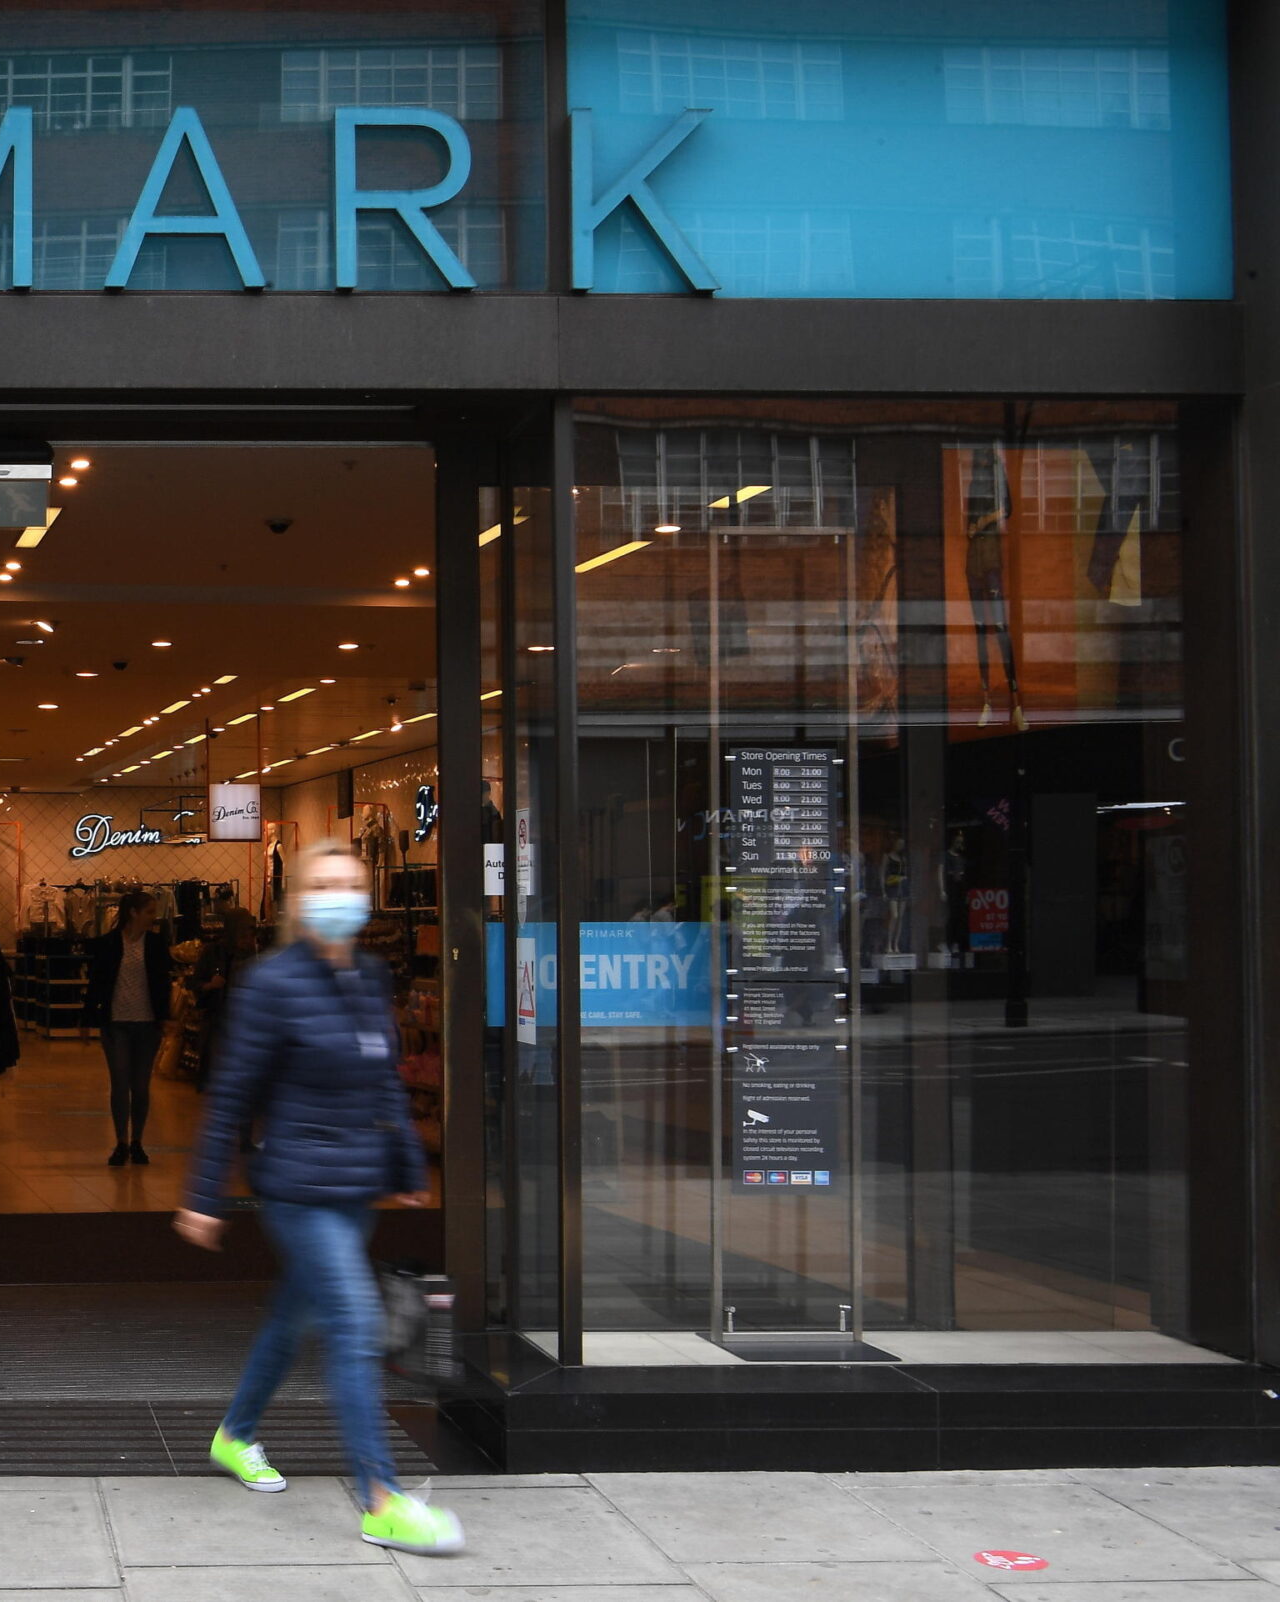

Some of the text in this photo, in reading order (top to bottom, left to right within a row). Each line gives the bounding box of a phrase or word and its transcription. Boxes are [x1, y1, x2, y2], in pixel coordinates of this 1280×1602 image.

[741, 752, 827, 762] Store Opening Times
[801, 768, 822, 776] 21.00
[742, 781, 762, 790] Tues
[801, 781, 821, 789] 21.00
[742, 795, 762, 804] Wed
[801, 796, 822, 804] 21.00
[212, 806, 244, 822] Denim
[801, 823, 822, 831] 21.00
[72, 813, 161, 857] Denim
[742, 837, 756, 846] Sat
[801, 837, 822, 845] 21.00
[742, 852, 759, 861] Sun
[808, 851, 830, 860] 18.00
[751, 866, 818, 874] www.primark.co.uk
[580, 930, 633, 938] PRIMARK
[540, 954, 695, 990] O ENTRY
